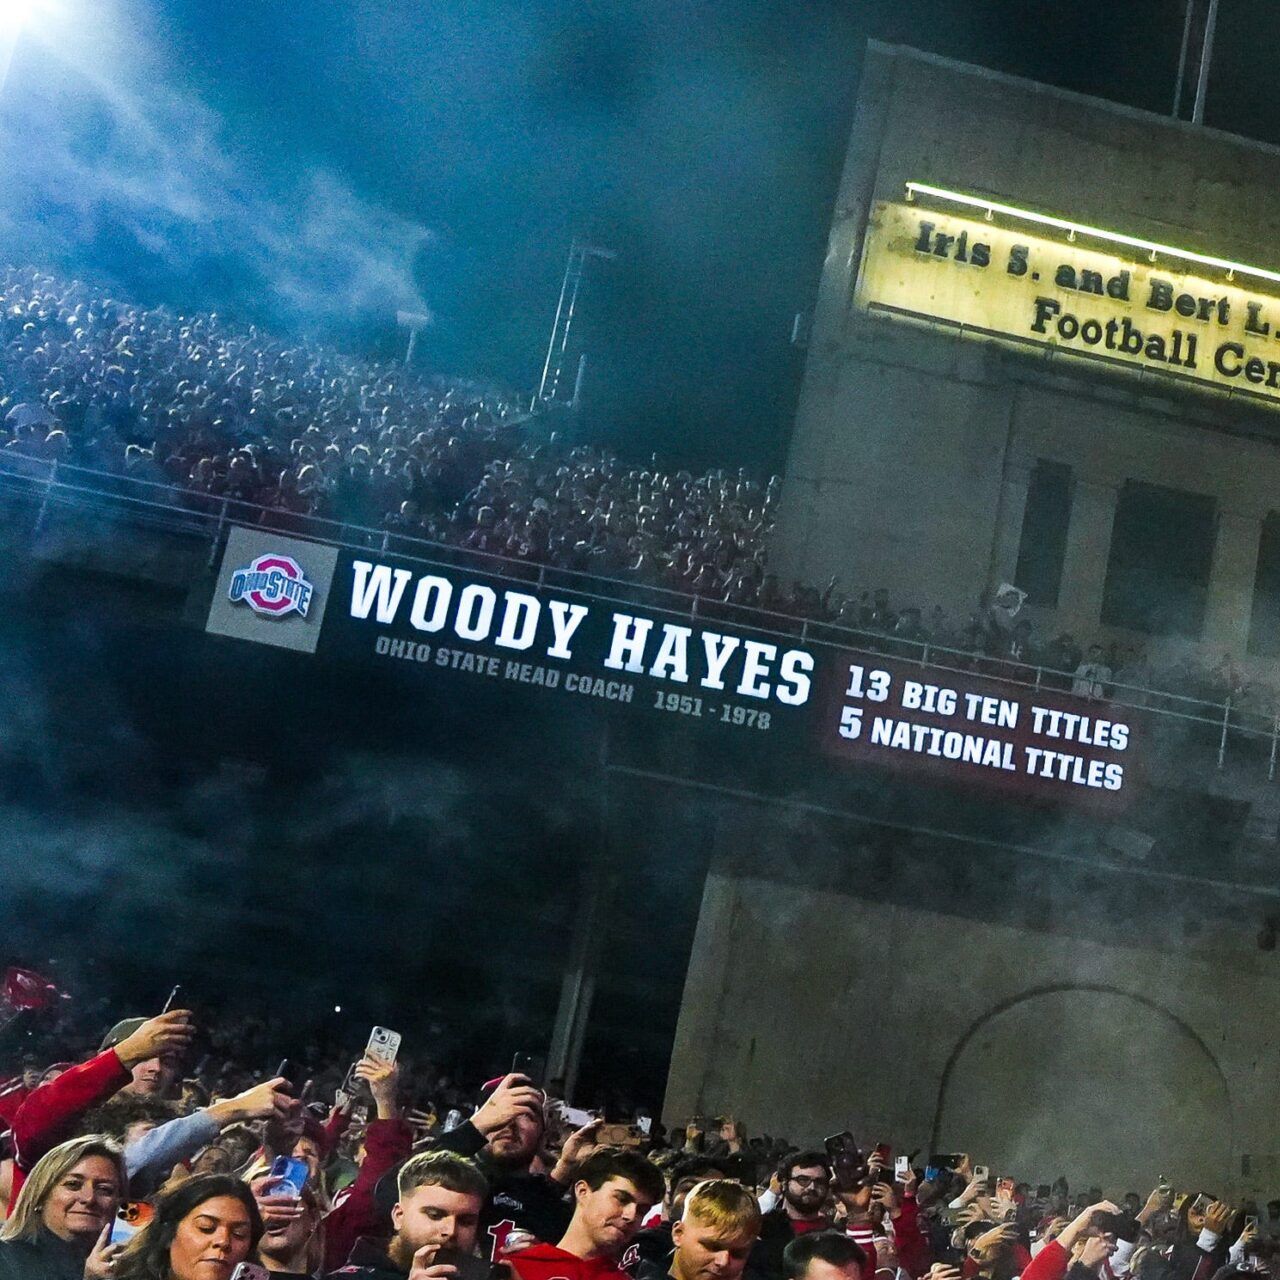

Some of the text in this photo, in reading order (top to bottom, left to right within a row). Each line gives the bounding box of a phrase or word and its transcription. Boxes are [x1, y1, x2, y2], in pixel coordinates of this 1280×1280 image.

[915, 221, 990, 269] Iris
[1007, 245, 1040, 281] S.
[1054, 261, 1130, 302] and
[1146, 279, 1230, 327] Bert
[1031, 298, 1198, 369] Football
[349, 560, 815, 706] WOODY HAYES
[376, 636, 430, 663] OHIO
[436, 648, 500, 678] STATE
[505, 661, 560, 693] HEAD
[566, 673, 634, 704] COACH
[654, 690, 703, 717] 1951
[720, 704, 772, 731] 1978
[846, 665, 1130, 751] 13 BIG TEN TITLES
[839, 706, 1123, 791] 5 NATIONAL TITLES
